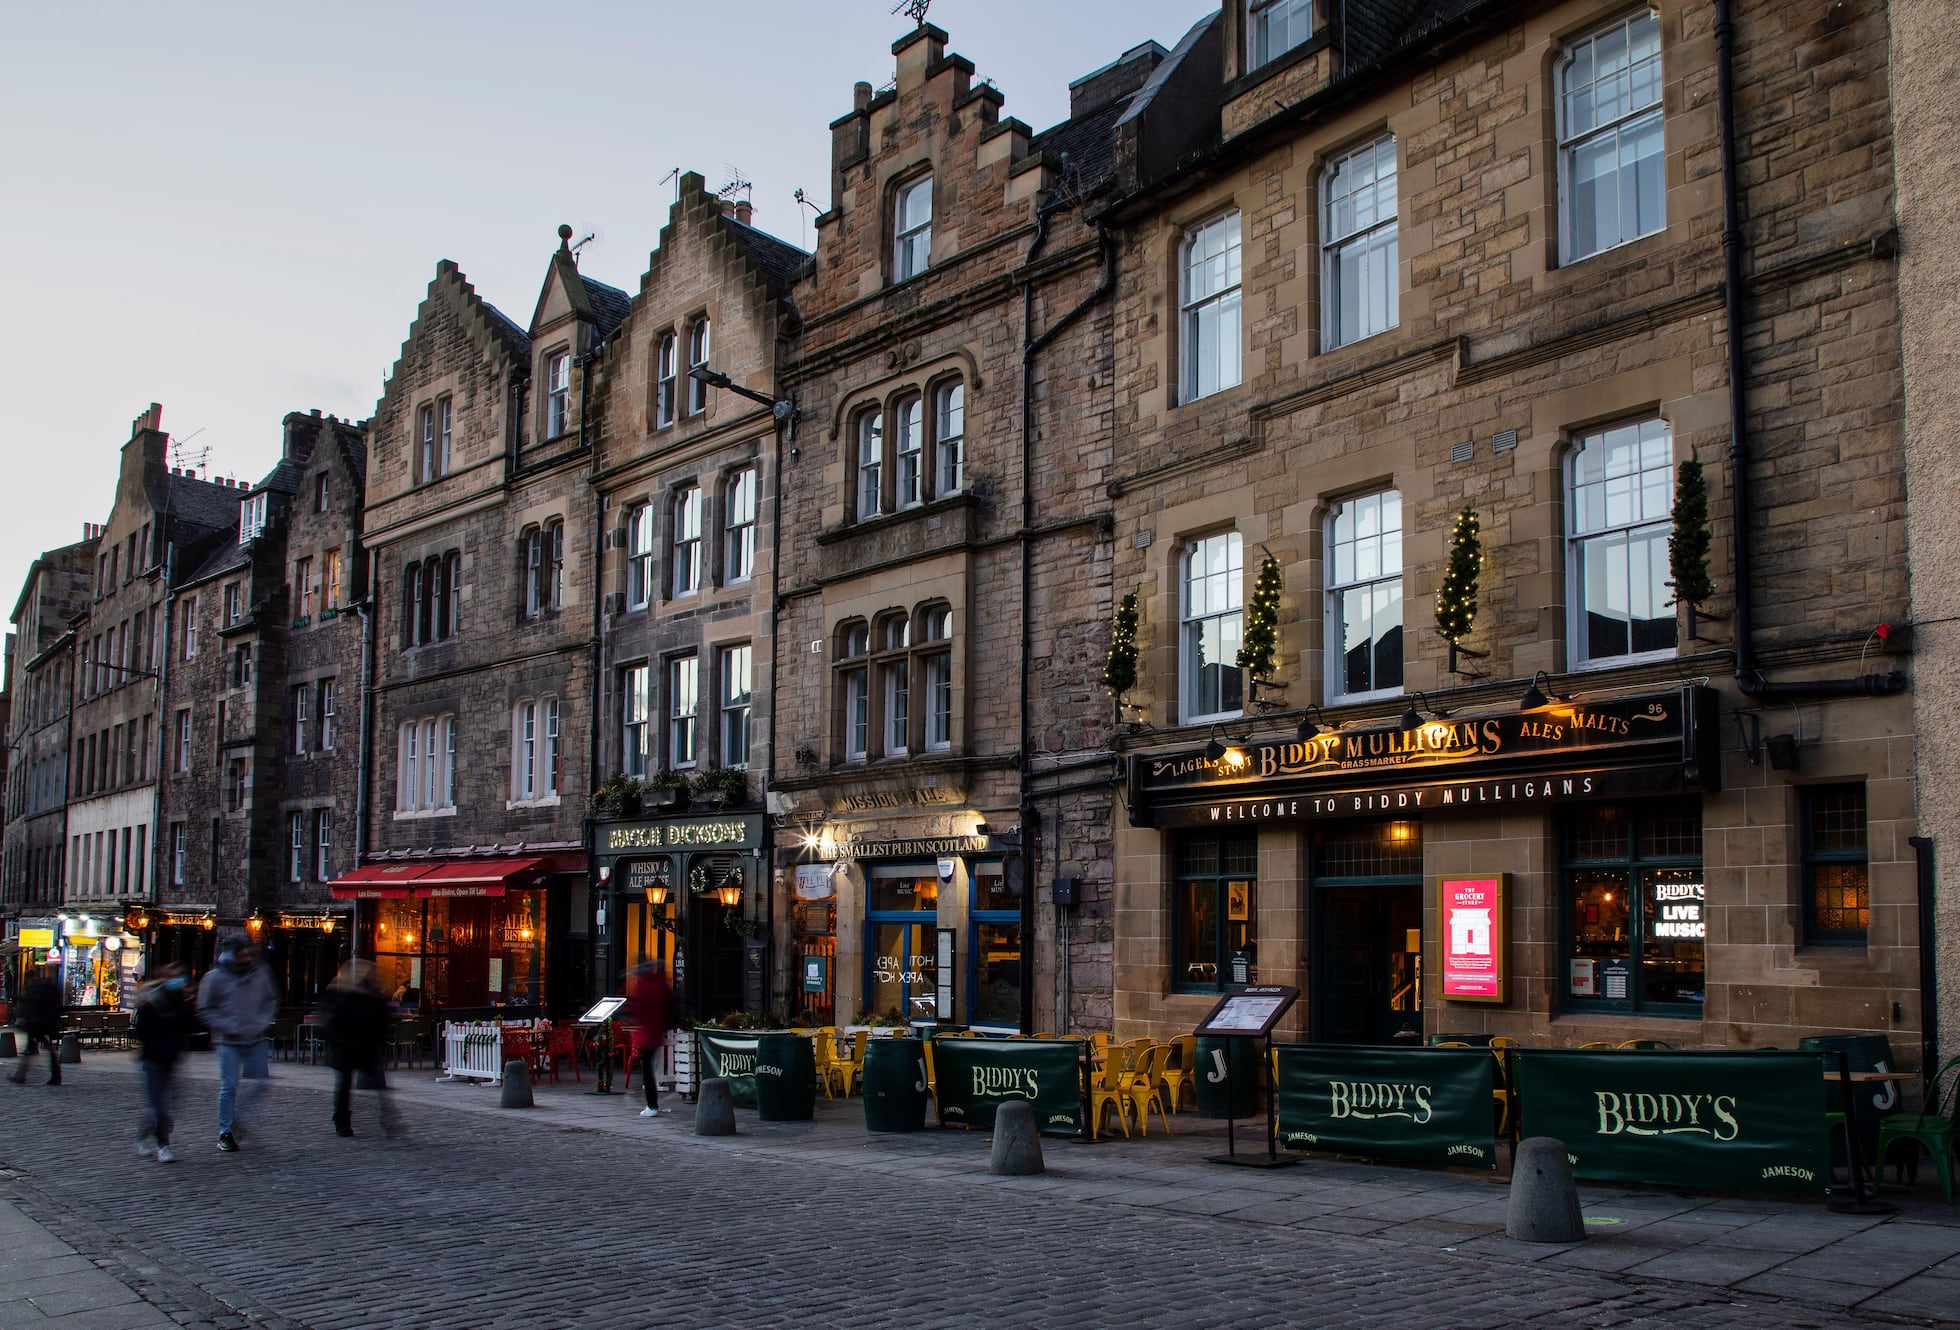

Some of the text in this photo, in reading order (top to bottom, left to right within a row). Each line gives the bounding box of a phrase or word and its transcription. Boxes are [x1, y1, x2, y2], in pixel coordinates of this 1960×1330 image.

[1648, 703, 1663, 714] 96
[1519, 721, 1564, 741] ALES
[1570, 712, 1630, 735] MALTS
[1346, 719, 1501, 758] MULLIGANS
[1260, 736, 1341, 777] BIDDY
[1340, 755, 1408, 769] GRASSMARKET
[1172, 757, 1219, 777] LAGERS
[840, 791, 898, 811] MISSION
[1210, 777, 1593, 821] WELCOME TO BIDDY MULLIGANS
[608, 826, 663, 849] MAGGIE
[820, 837, 987, 859] THE SMALLEST PUB IN SCOTLAND
[630, 860, 669, 874] WHISKY &
[629, 874, 670, 888] ALE HOSE
[1656, 884, 1705, 901] BIDDY'S
[504, 913, 535, 930] ALBA
[1663, 905, 1699, 920] LIVE
[1655, 922, 1706, 938] MUSIC
[719, 1052, 757, 1077] BIDDY'
[755, 1064, 783, 1077] AMESON
[915, 1056, 928, 1093] J
[1207, 1048, 1229, 1083] J
[971, 1065, 1039, 1099] BIDDY'S
[1872, 1060, 1898, 1111] J
[944, 1106, 965, 1115] JAMESON
[1329, 1080, 1433, 1124] BIDDY'S
[1049, 1114, 1074, 1125] JAMESON
[1594, 1091, 1740, 1141] BIDDY'S
[1287, 1131, 1318, 1143] JAMESON
[1447, 1145, 1484, 1158] JAMESON
[1761, 1165, 1815, 1182] JAMESON
